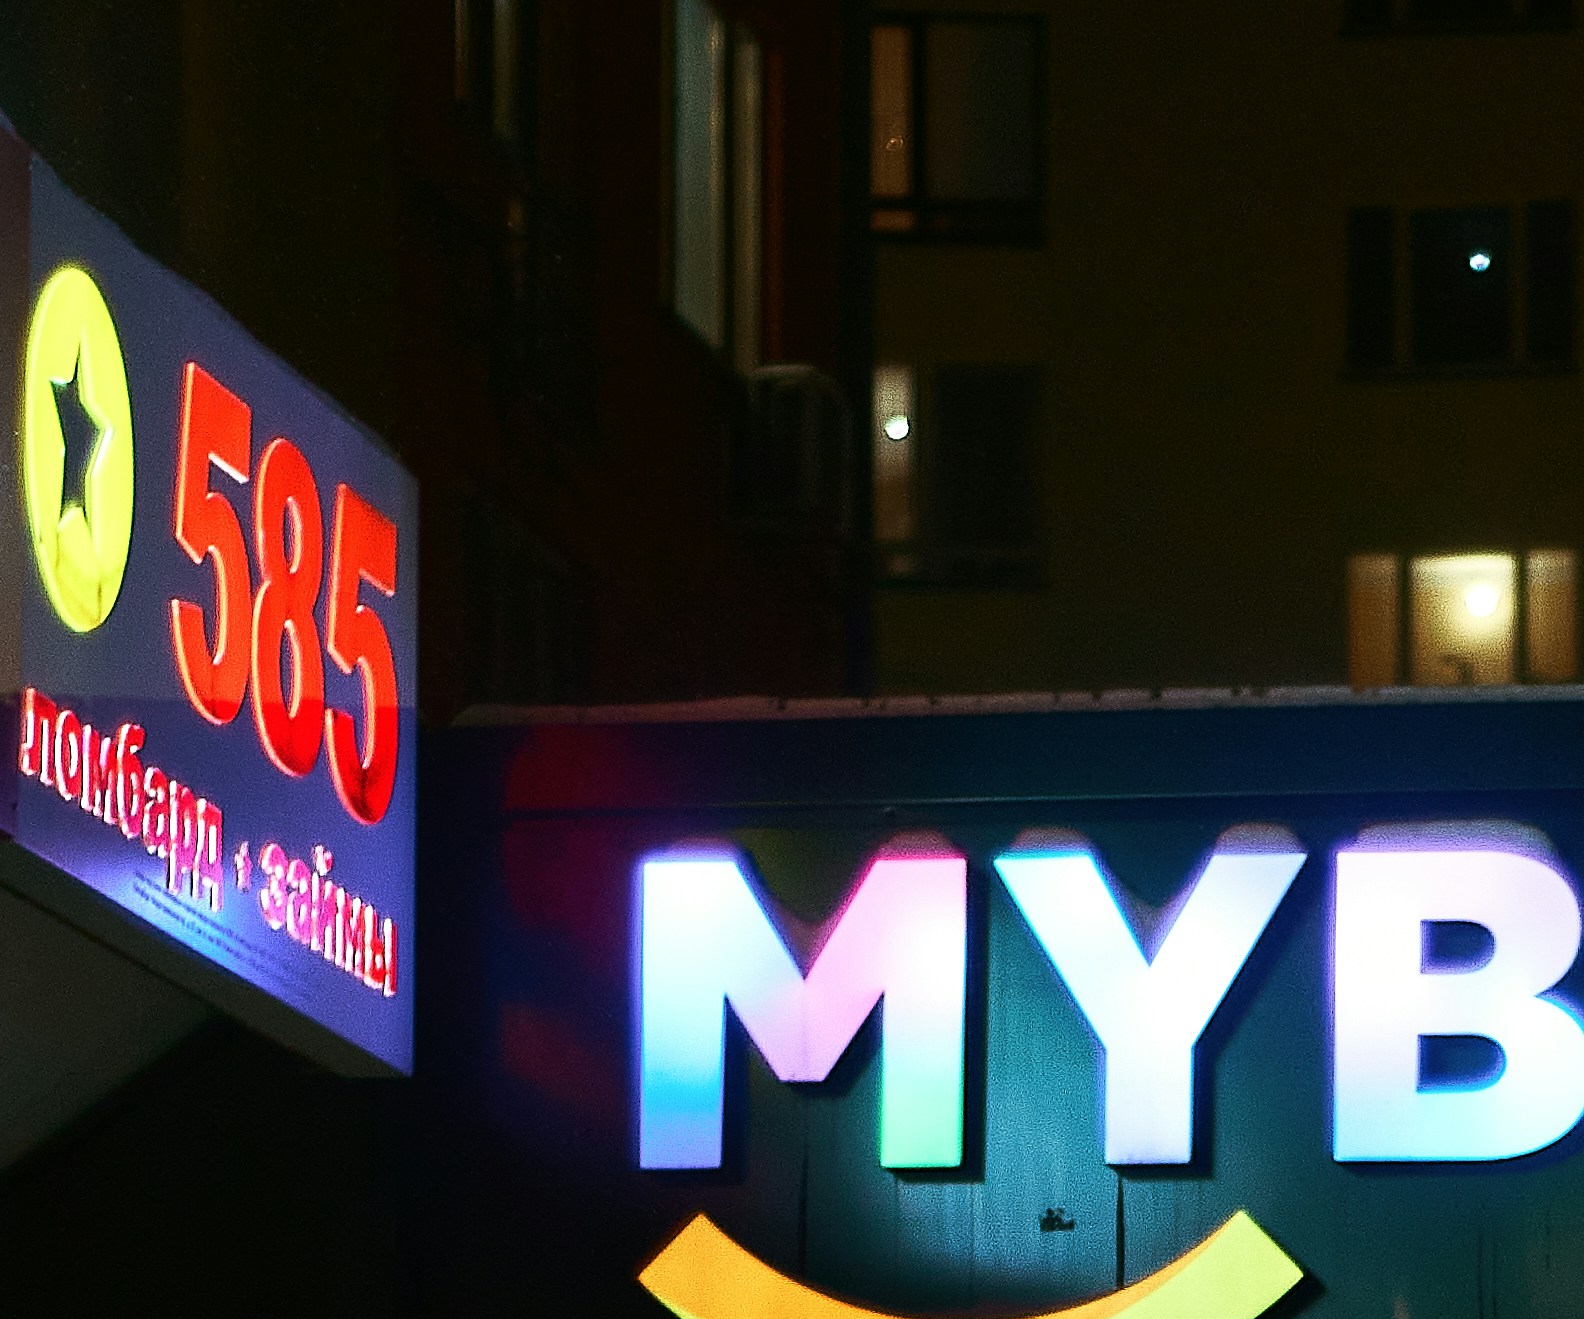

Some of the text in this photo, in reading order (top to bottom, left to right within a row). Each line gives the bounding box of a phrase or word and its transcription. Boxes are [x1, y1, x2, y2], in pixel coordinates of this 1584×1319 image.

[171, 361, 399, 825] 585
[20, 686, 224, 913] ломбард
[260, 842, 398, 998] займы
